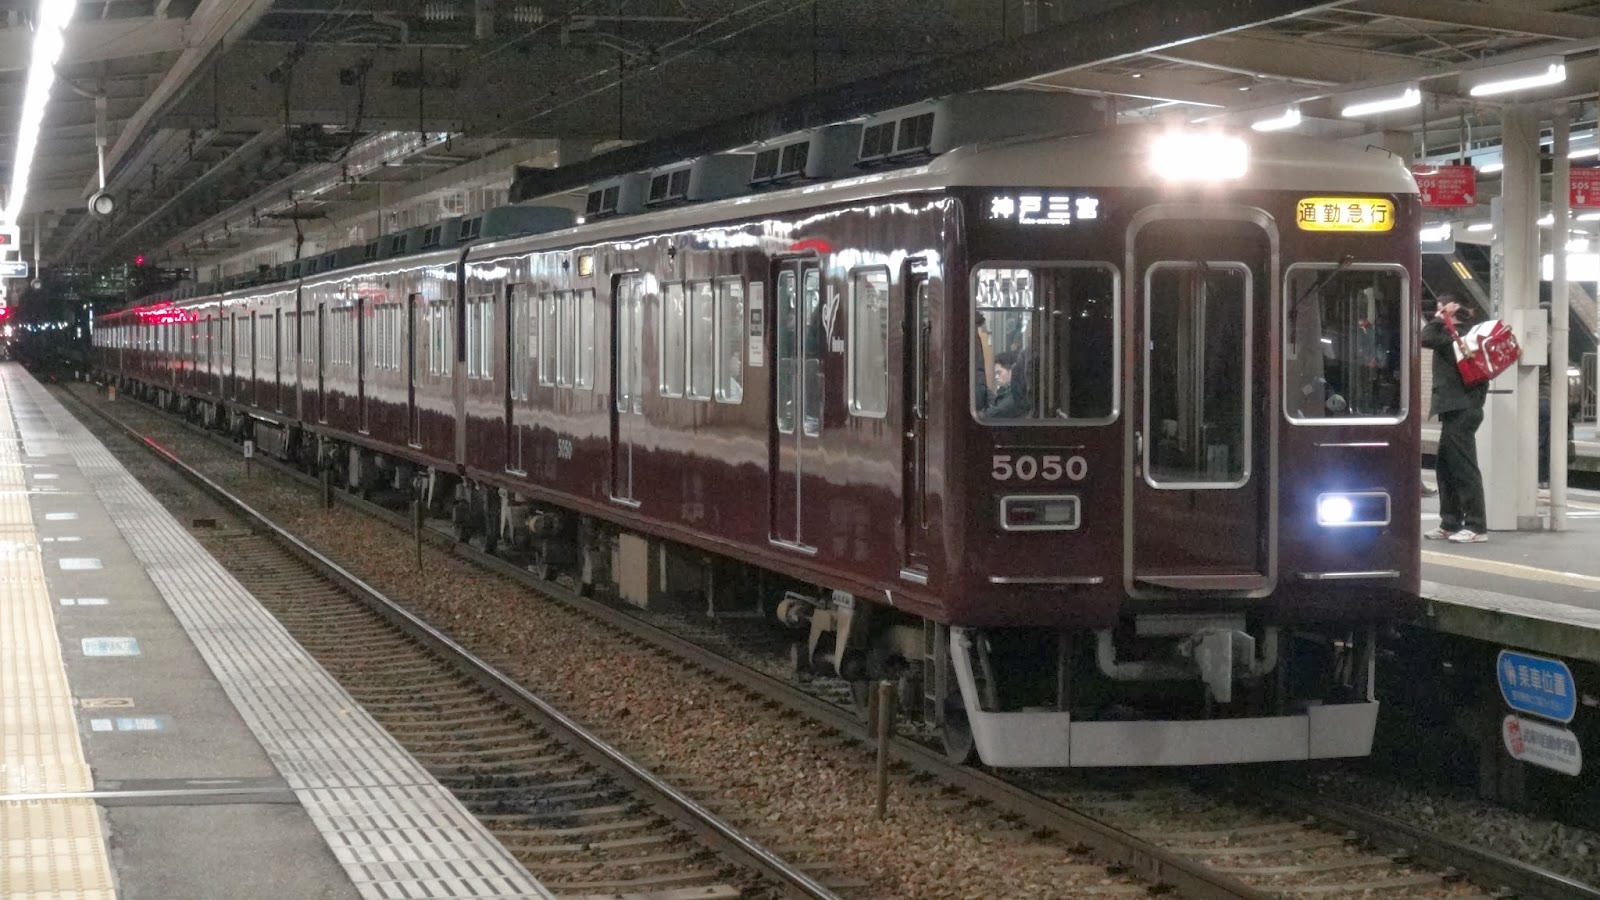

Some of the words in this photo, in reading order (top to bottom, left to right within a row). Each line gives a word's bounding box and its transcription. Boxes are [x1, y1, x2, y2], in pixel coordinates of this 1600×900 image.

[1418, 180, 1436, 188] SOS
[1571, 182, 1590, 190] SOS
[990, 196, 1099, 219] 神戸三宮
[1299, 203, 1388, 223] 通勤急行
[991, 455, 1088, 481] 5050
